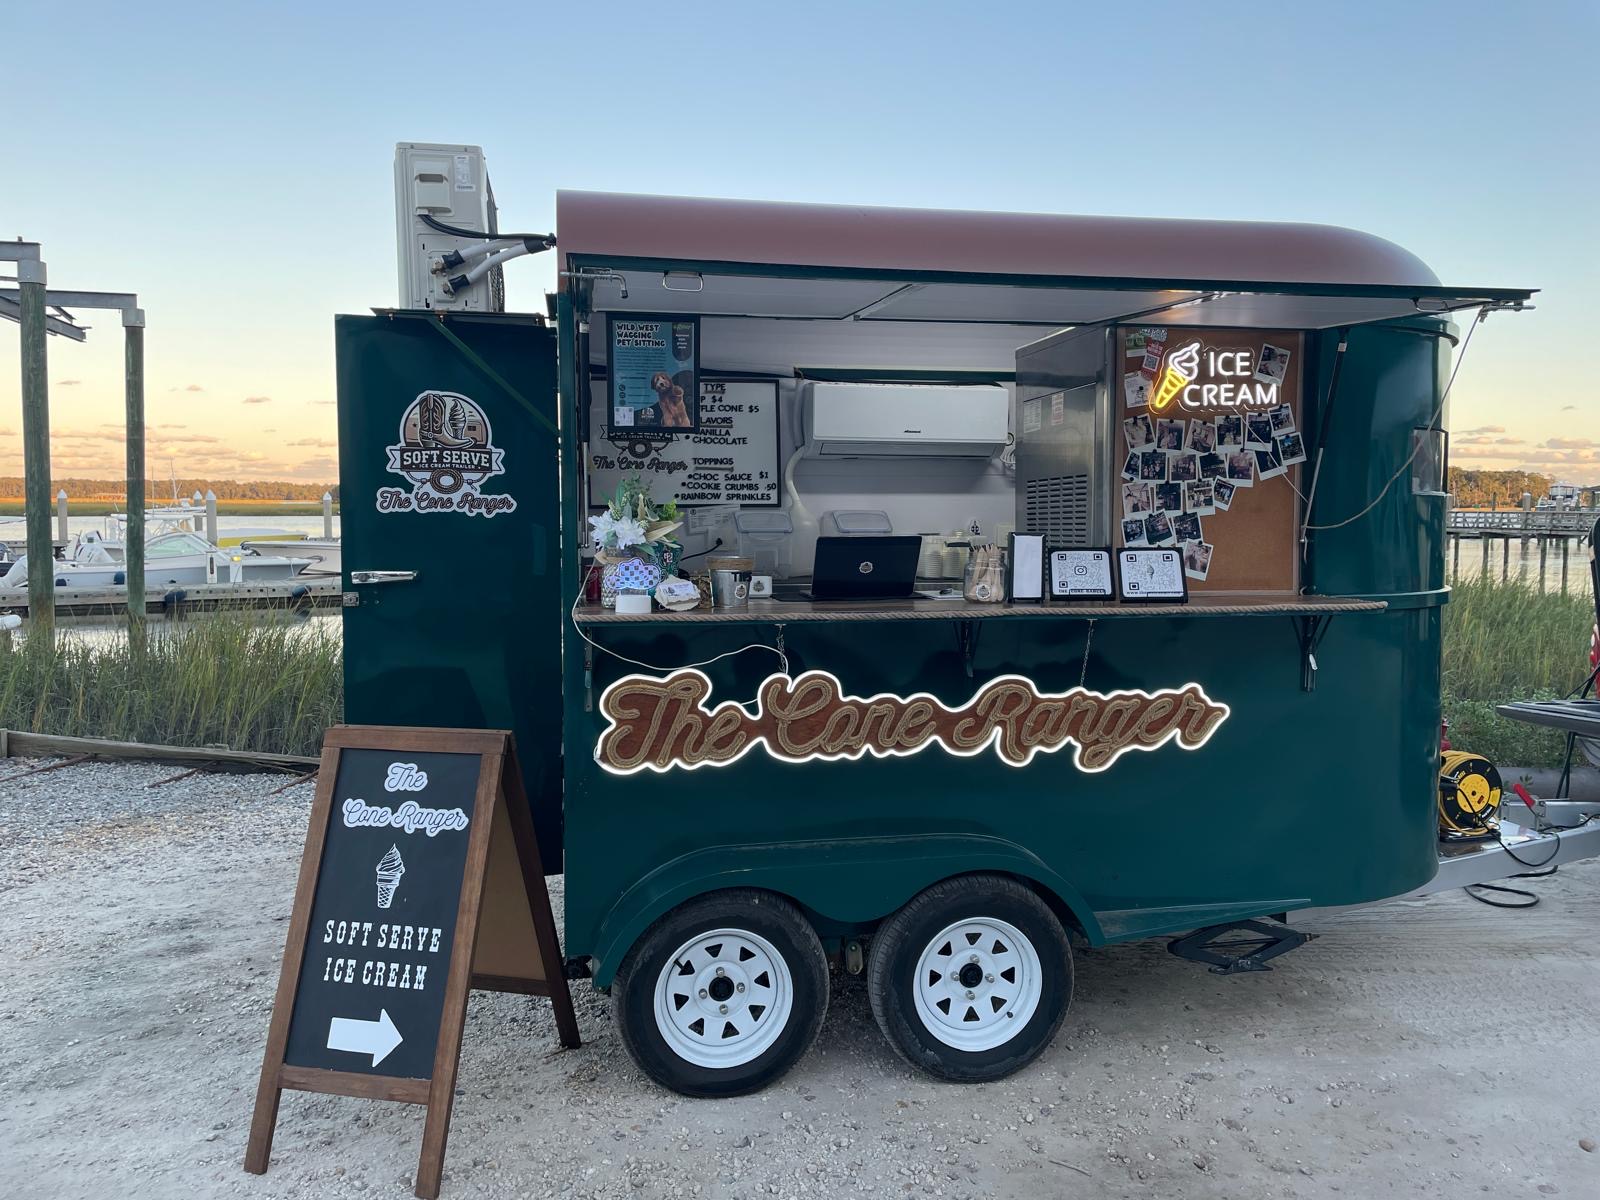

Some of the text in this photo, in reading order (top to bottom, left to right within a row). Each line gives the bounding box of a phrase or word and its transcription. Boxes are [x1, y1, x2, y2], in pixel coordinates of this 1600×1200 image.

[616, 323, 660, 332] WILD WEST
[616, 331, 652, 339] WAGGING
[616, 339, 632, 347] PET
[634, 339, 666, 347] SITTING
[1209, 352, 1252, 377] ICE
[704, 383, 726, 391] TYPE
[711, 395, 723, 404] $4
[1183, 383, 1278, 407] CREAM
[700, 404, 760, 413] FLE CONE $5
[700, 416, 733, 424] LAVORS
[700, 428, 731, 436] ANILLA
[692, 436, 748, 445] CHOCOLATE
[403, 450, 490, 467] SOFT SERVE
[693, 457, 734, 465] TOPPINGS
[593, 455, 615, 469] The
[647, 457, 688, 474] Ranger
[692, 472, 719, 480] CHOC
[724, 473, 752, 481] SAUCE
[687, 481, 721, 490] COOKIE
[724, 483, 759, 491] CRUMBS
[680, 492, 771, 501] RAINBOW SPRINKLES
[380, 490, 514, 515] The Cone Ranger
[606, 679, 1224, 769] The Cone Ranger
[386, 764, 426, 790] The
[344, 800, 466, 835] Cone Ranger
[323, 919, 442, 953] SOFT SERVE
[323, 957, 428, 991] ICE CREAM
